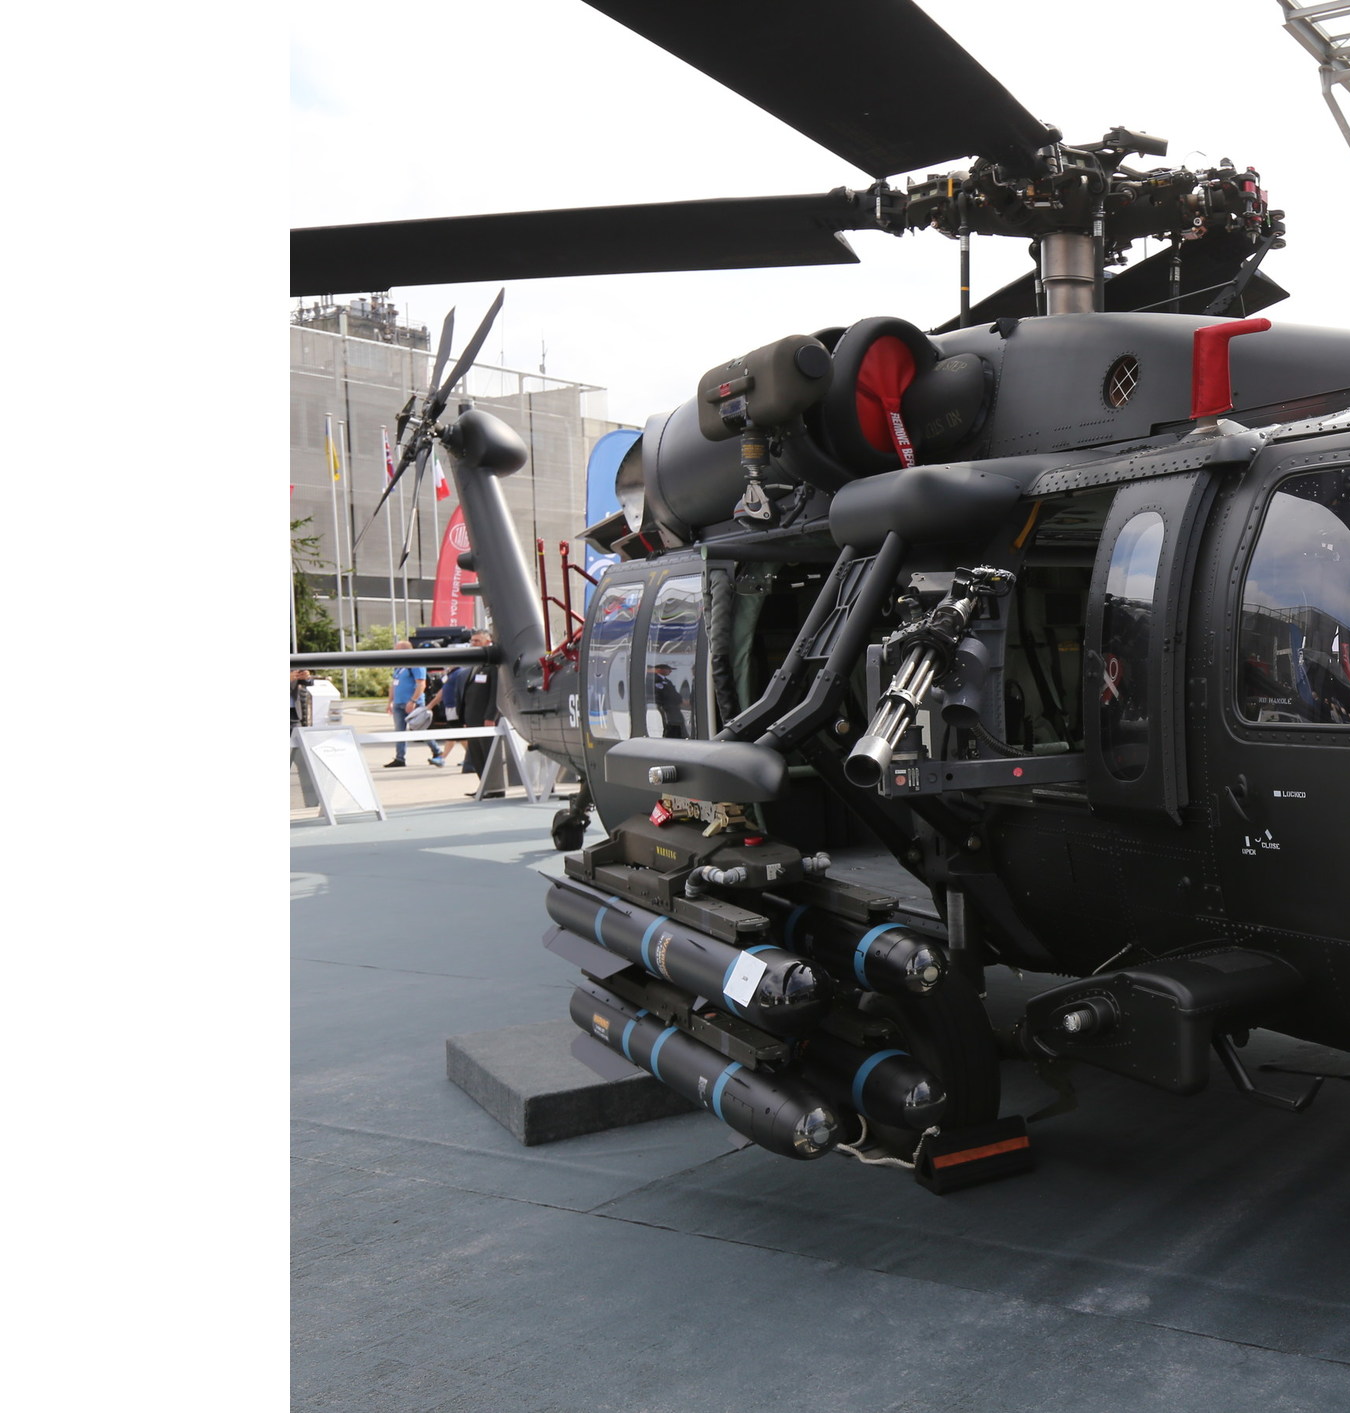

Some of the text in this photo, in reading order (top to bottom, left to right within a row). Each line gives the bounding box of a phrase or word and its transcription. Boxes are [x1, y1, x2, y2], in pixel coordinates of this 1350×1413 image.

[890, 412, 910, 446] REMOVE
[450, 599, 458, 618] YOU
[1282, 790, 1307, 798] LOCKED
[1261, 841, 1281, 850] CLOSE
[1241, 848, 1257, 856] OPEN
